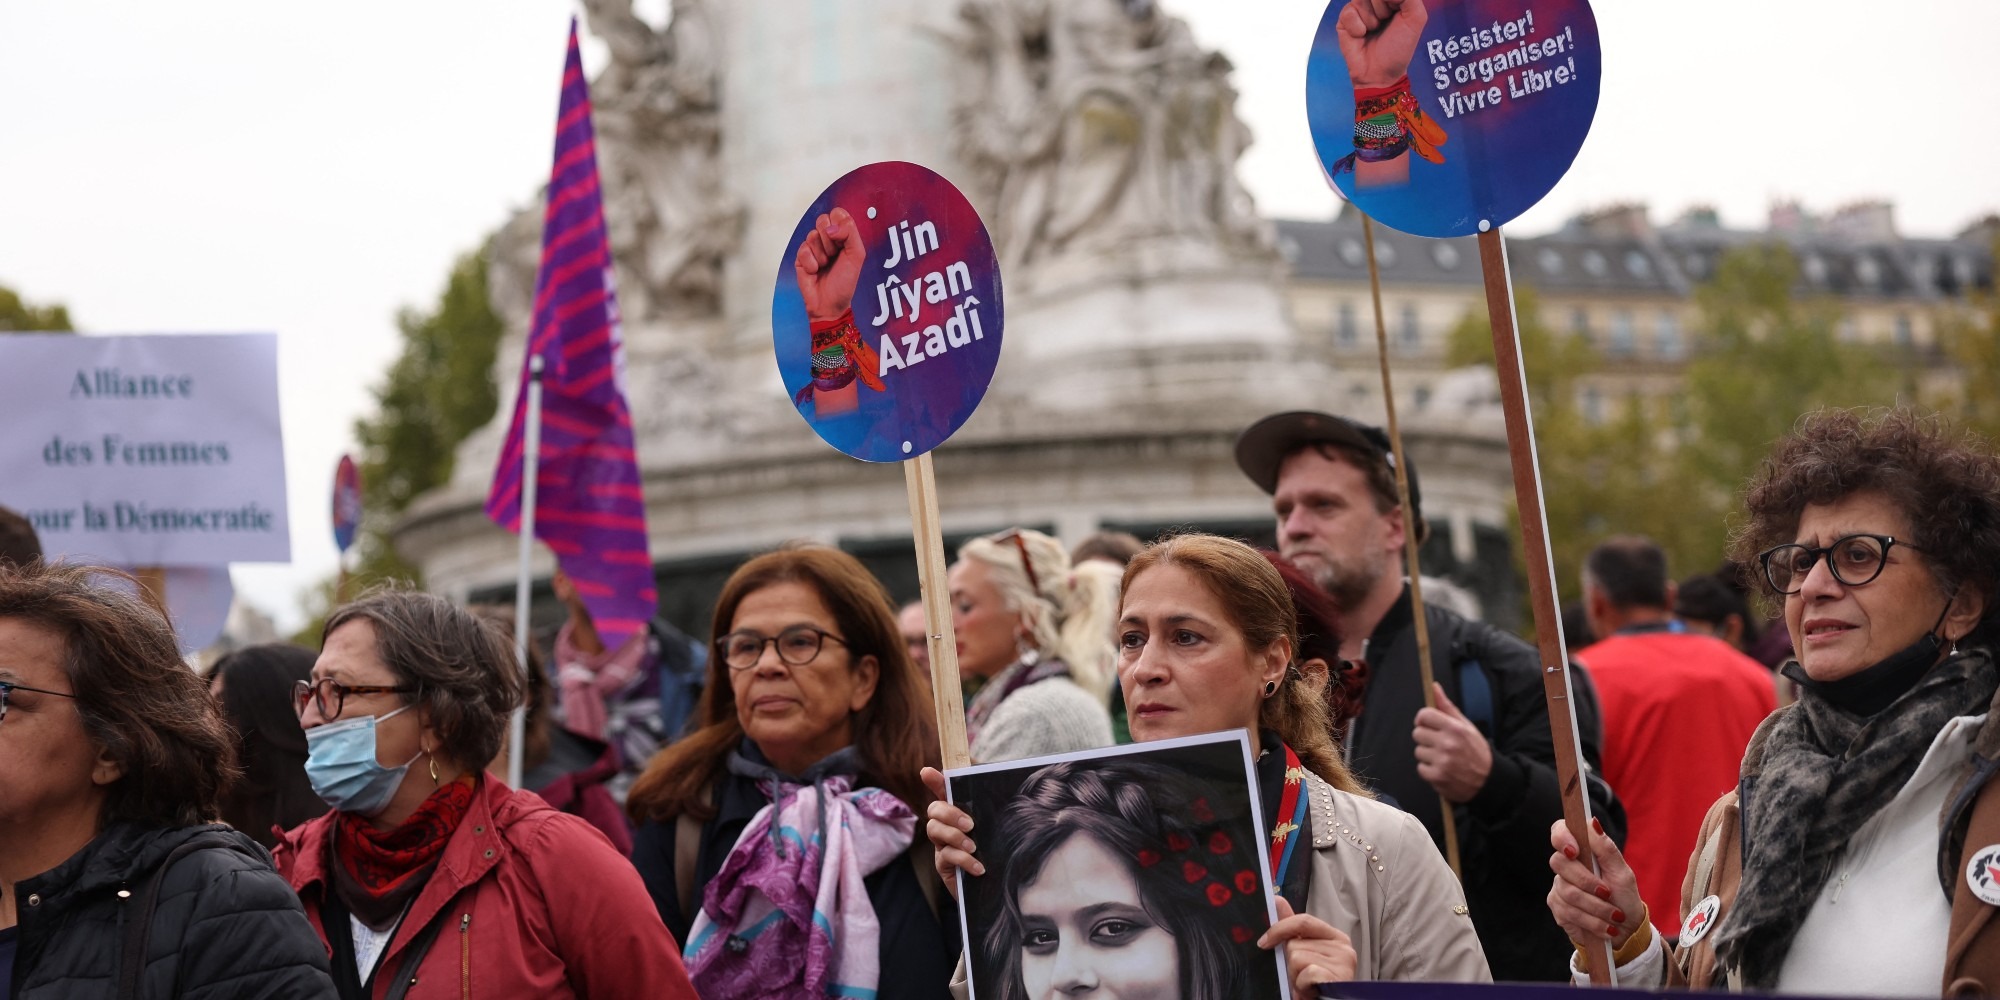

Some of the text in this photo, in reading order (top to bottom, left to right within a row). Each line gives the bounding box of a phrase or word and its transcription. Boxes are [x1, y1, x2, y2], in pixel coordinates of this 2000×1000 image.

[1427, 9, 1535, 64] Résister!
[1433, 25, 1574, 90] S'organiser!
[1438, 56, 1577, 118] Vivre Libre!
[884, 220, 939, 268] Jin
[871, 261, 973, 326] Jîyan
[879, 295, 983, 377] Azadî
[71, 368, 193, 398] Alliance
[43, 434, 229, 464] des Femmes
[26, 500, 271, 533] our la Démocratie
